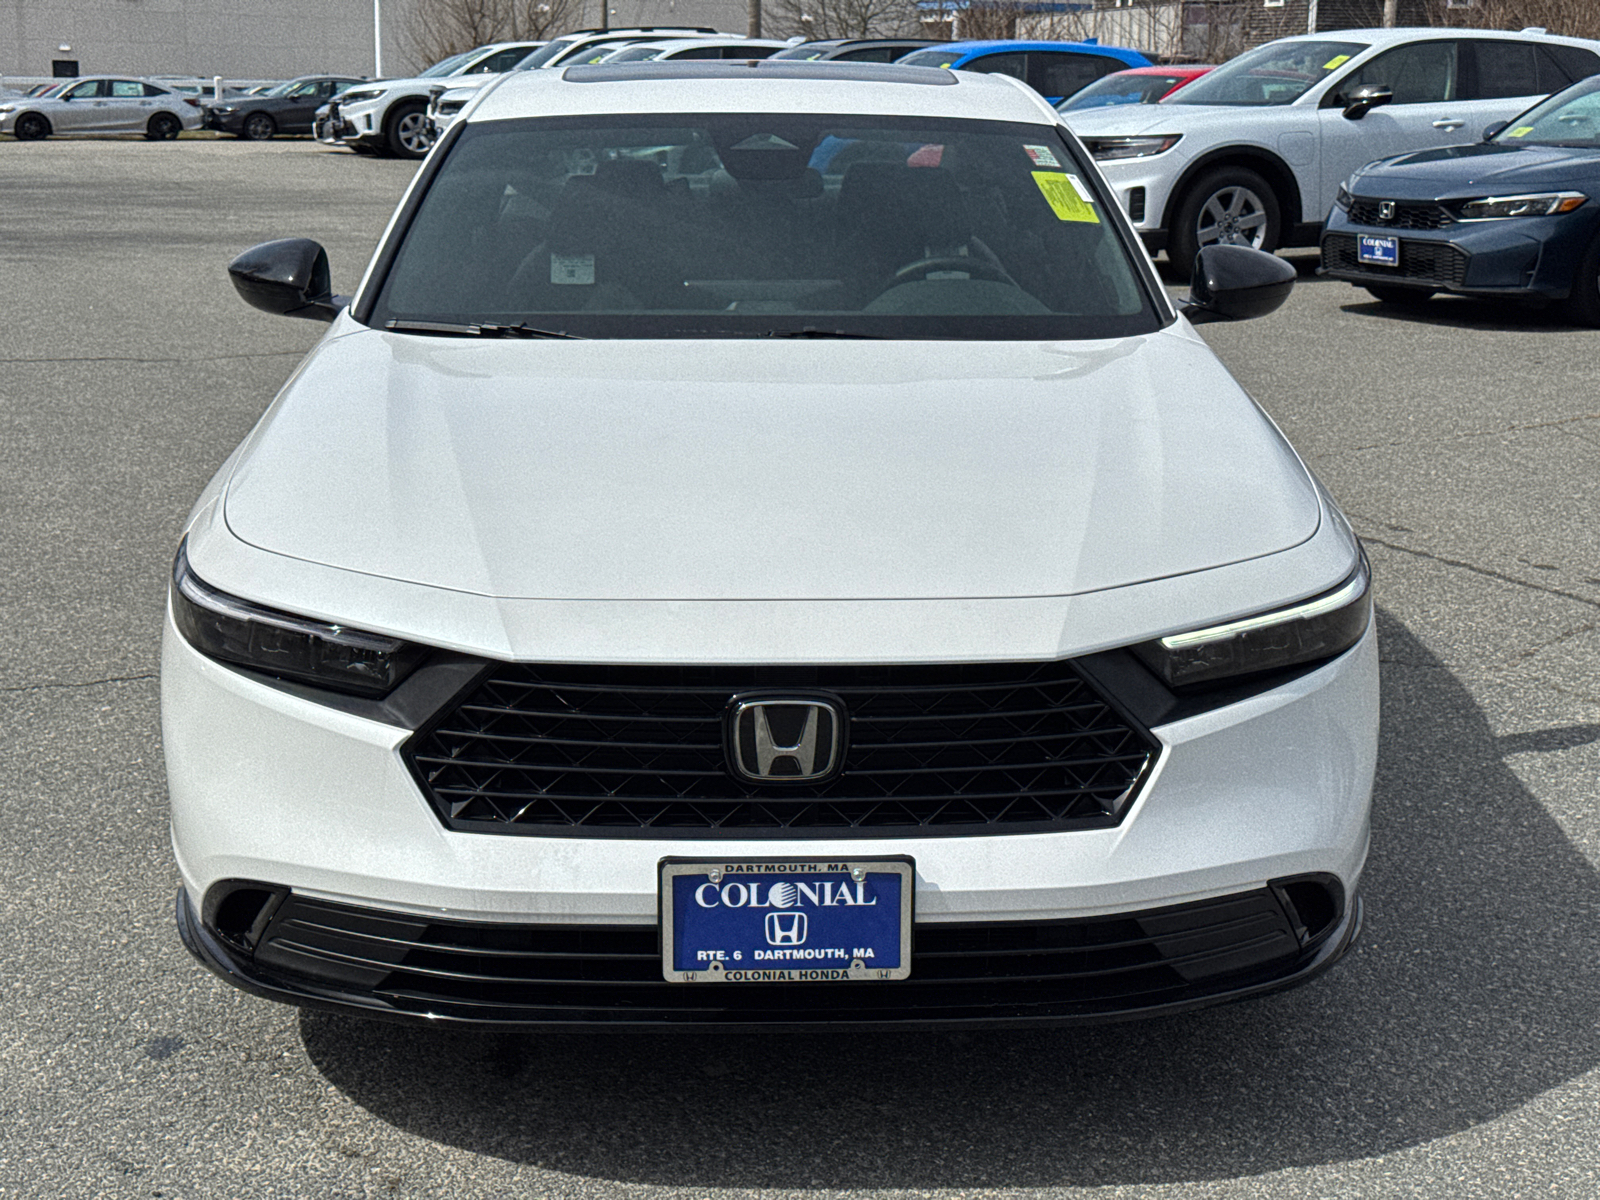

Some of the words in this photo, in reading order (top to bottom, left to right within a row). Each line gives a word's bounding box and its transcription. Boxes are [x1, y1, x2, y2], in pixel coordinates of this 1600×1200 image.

[724, 864, 822, 873] DARTMOUTH,
[827, 863, 849, 872] MA
[695, 881, 877, 908] COLONIAL
[697, 950, 729, 960] RTE.
[733, 950, 742, 960] 6
[754, 948, 848, 960] DARTMOUTH,
[853, 948, 875, 958] MA
[724, 970, 795, 981] COLONIAL
[798, 970, 849, 980] HONDA
